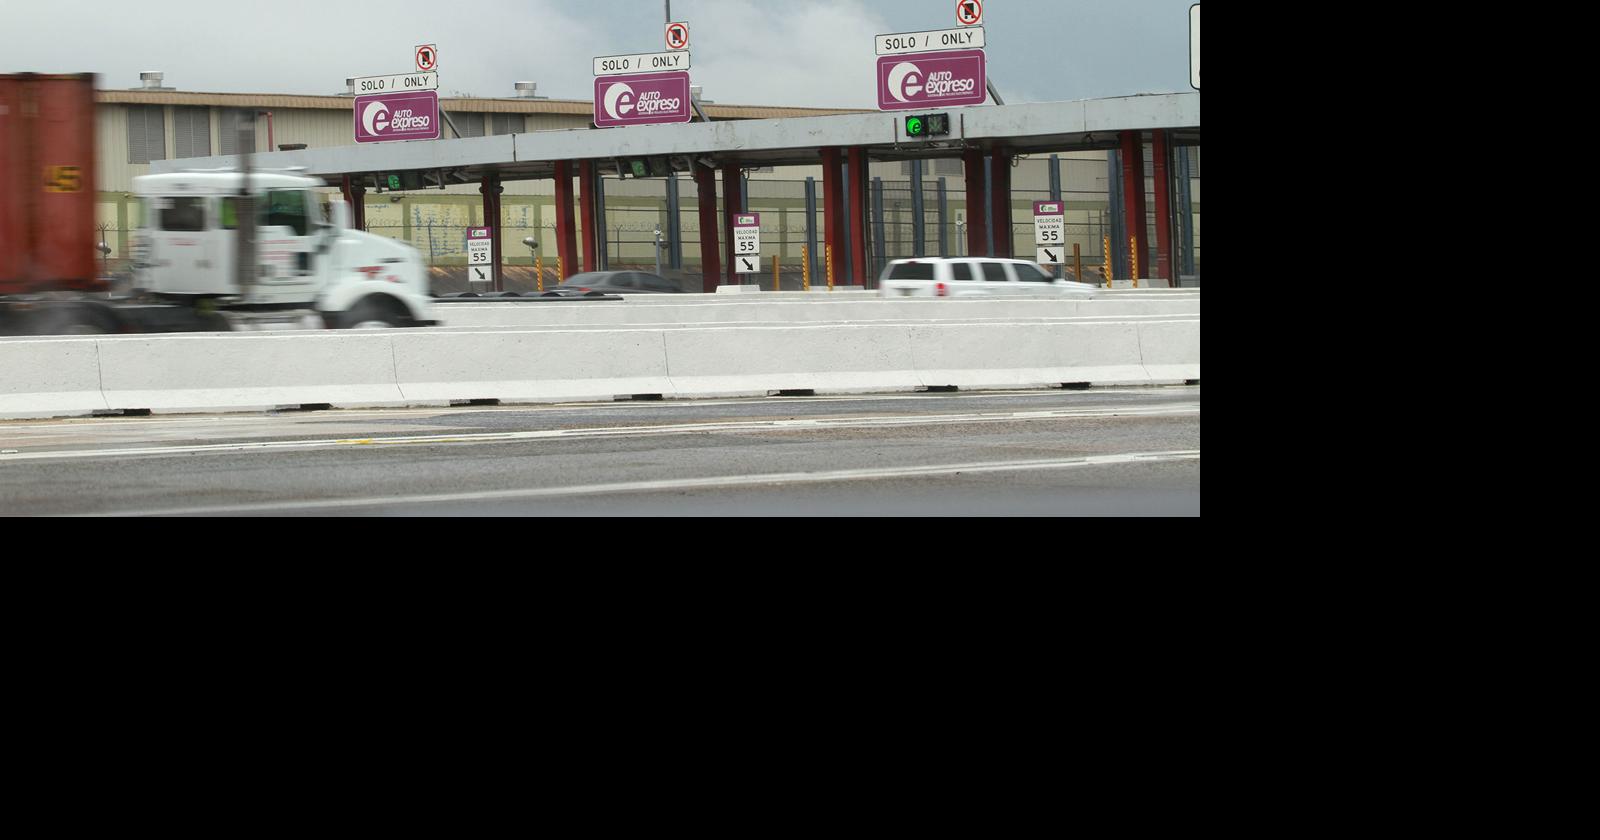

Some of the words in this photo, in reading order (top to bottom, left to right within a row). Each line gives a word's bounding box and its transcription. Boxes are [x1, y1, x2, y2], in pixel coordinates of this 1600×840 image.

[885, 36, 916, 50] SOLO
[941, 32, 973, 45] ONLY
[602, 59, 629, 71] SOLO
[652, 55, 680, 67] ONLY
[928, 71, 952, 81] AUTO
[361, 80, 385, 91] SOLO
[404, 76, 429, 87] ONLY
[925, 78, 974, 96] expreso
[639, 91, 661, 101] AUTO
[636, 98, 680, 114] expreso
[393, 109, 413, 119] AUTO
[391, 116, 430, 131] expreso
[1042, 230, 1058, 241] 55
[740, 241, 755, 251] 55
[473, 252, 487, 262] 55
